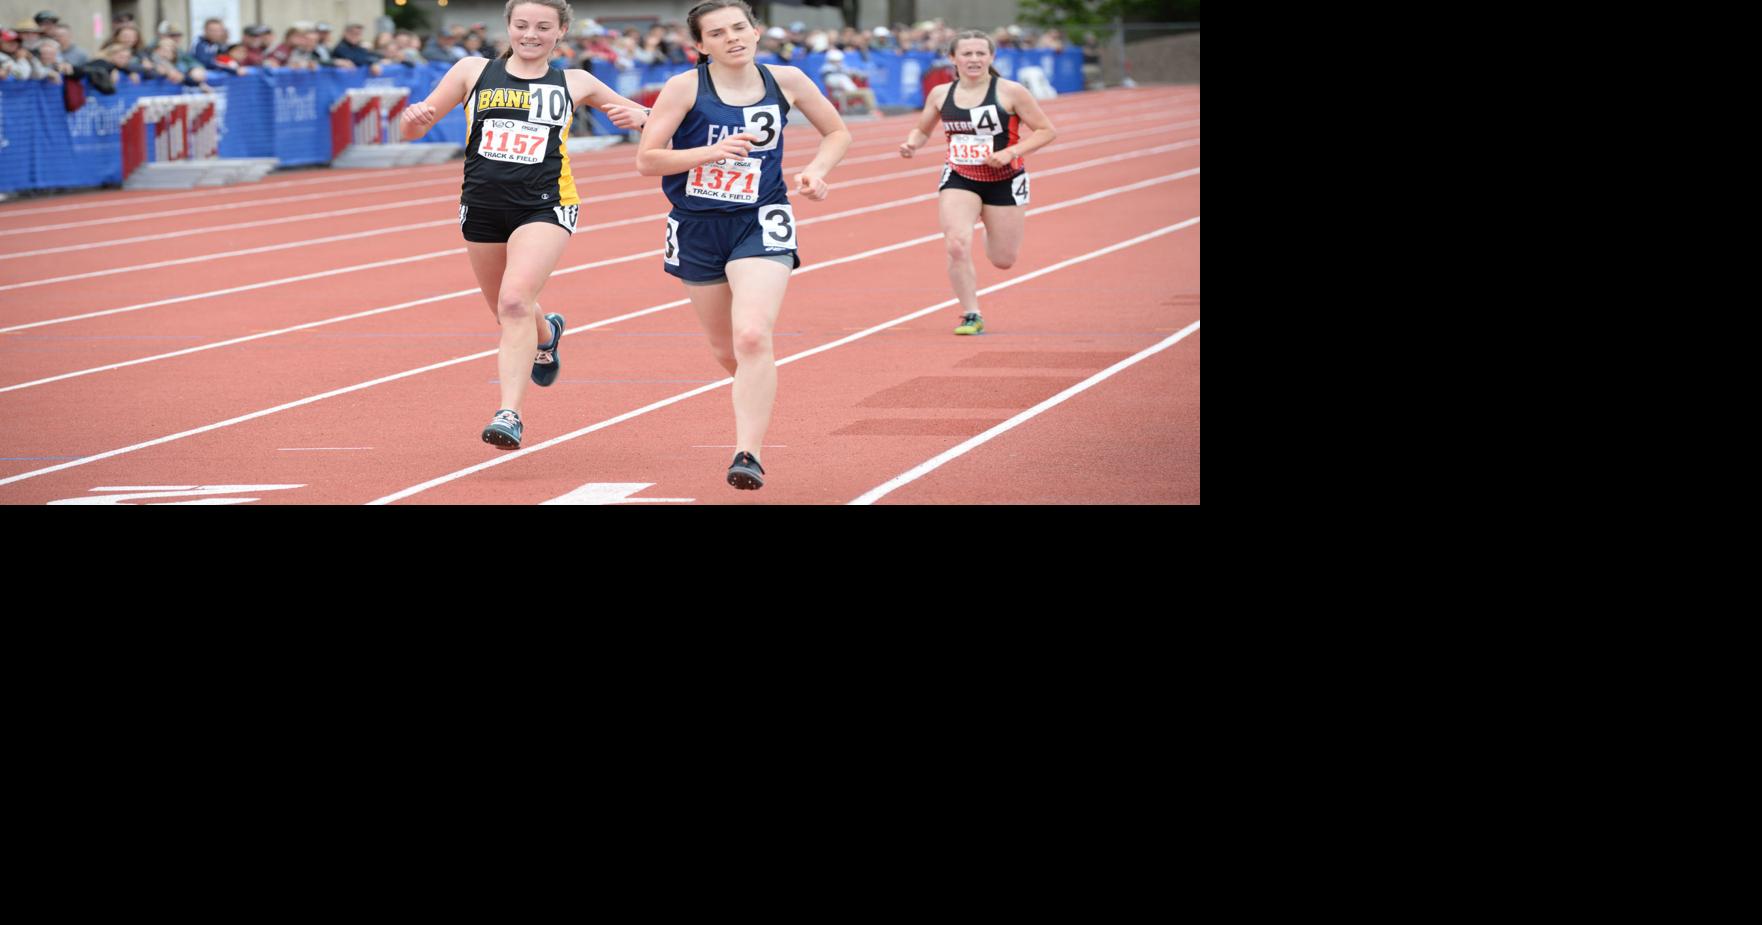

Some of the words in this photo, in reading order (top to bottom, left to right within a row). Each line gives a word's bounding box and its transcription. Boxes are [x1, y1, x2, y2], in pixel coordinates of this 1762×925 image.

[532, 88, 565, 120] 10
[750, 111, 775, 146] 3
[977, 110, 997, 131] 4
[483, 131, 544, 155] 1157
[953, 144, 990, 159] 1353
[484, 151, 506, 159] TRACK
[516, 155, 537, 163] FIELD
[691, 166, 754, 193] 1371
[1015, 178, 1028, 200] 4
[693, 188, 718, 197] TRACK
[765, 209, 792, 242] 3
